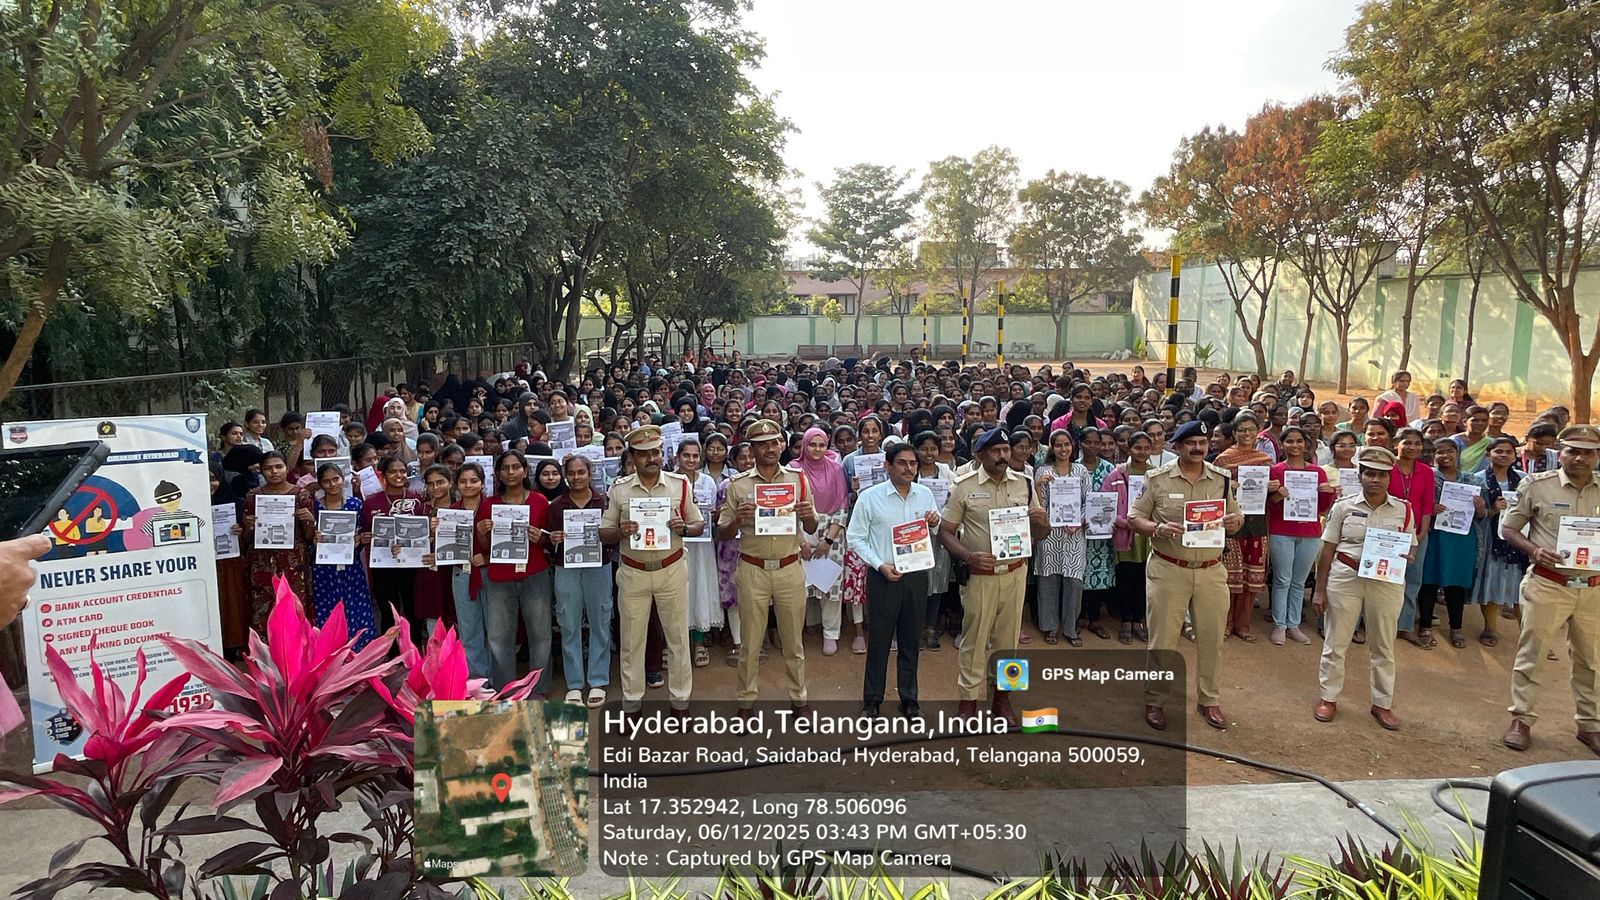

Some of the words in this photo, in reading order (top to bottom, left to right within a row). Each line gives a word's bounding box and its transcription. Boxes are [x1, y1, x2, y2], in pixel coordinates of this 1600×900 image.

[40, 567, 96, 590] NEVER
[100, 561, 152, 581] SHARE
[156, 556, 197, 574] YOUR
[55, 601, 81, 612] BANK
[83, 595, 124, 607] ACCOUNT
[126, 587, 183, 602] CREDENTIALS
[56, 616, 77, 626] ATM
[79, 613, 103, 623] CARD
[57, 629, 91, 642] SIGNED
[93, 623, 128, 636] CHEQUE
[130, 619, 155, 630] BOOK
[60, 645, 79, 656] ANY
[123, 631, 171, 645] DOCUMT
